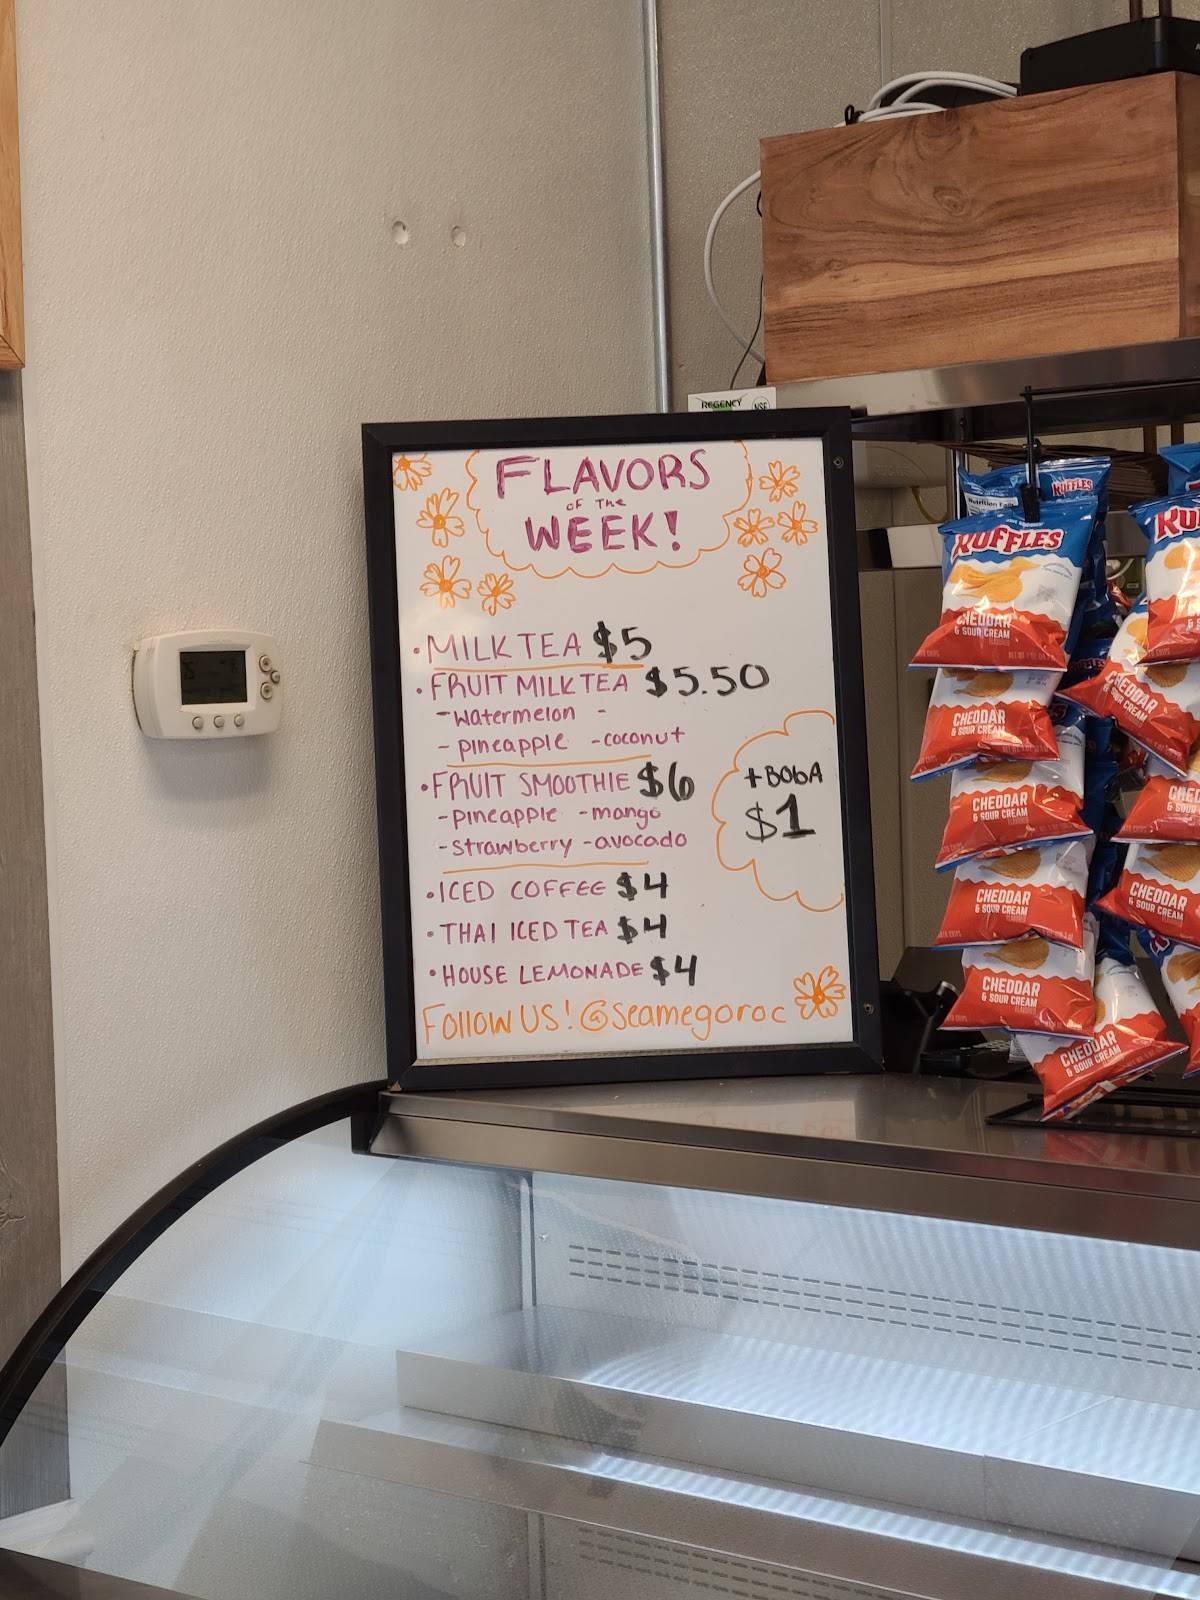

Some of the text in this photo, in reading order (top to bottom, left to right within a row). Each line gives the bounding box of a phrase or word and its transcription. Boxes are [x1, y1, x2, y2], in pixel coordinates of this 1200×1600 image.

[701, 398, 743, 409] REGENCY
[496, 449, 710, 499] FLAVORS
[1052, 478, 1093, 496] RUFFLES
[525, 510, 681, 553] WEEK!
[951, 526, 1064, 563] RUFFLES
[956, 610, 1012, 628] CHEDDAR
[962, 627, 982, 637] SOUR
[984, 628, 1010, 639] CREAM
[427, 620, 652, 664] MILK TEA $5
[431, 663, 770, 700] FRUIT MILK TEA $5.50
[1105, 670, 1159, 714] CHEDDAR
[953, 709, 1006, 726] CHEDDAR
[1110, 687, 1123, 706] SOUR
[1123, 699, 1149, 722] CREAM
[958, 725, 976, 736] SOUR
[977, 724, 1006, 736] CREAM
[432, 761, 695, 802] FRUIT SMOOTHIE $6
[972, 792, 1028, 812] CHEDDAR
[980, 812, 1000, 821] SOUR
[1001, 807, 1028, 819] CREAM
[745, 793, 816, 843] $1
[439, 872, 669, 902] ICED COFFEE $4
[976, 888, 1031, 906] CHEDDAR
[1129, 881, 1188, 911] CHEDDAR
[982, 904, 1000, 914] SOUR
[1001, 905, 1028, 916] CREAM
[1135, 901, 1156, 913] SOUR
[1157, 905, 1184, 921] CREAM
[440, 914, 668, 945] THAI ICED TEA $4
[442, 955, 698, 987] HOUSE LEMONADE $4
[982, 976, 1041, 997] CHEDDAR
[989, 993, 1009, 1005] SOUR
[1010, 995, 1038, 1008] CREAM
[1060, 1030, 1119, 1068] CHEDDAR
[1074, 1058, 1094, 1075] SOUR
[1095, 1042, 1122, 1065] CREAM
